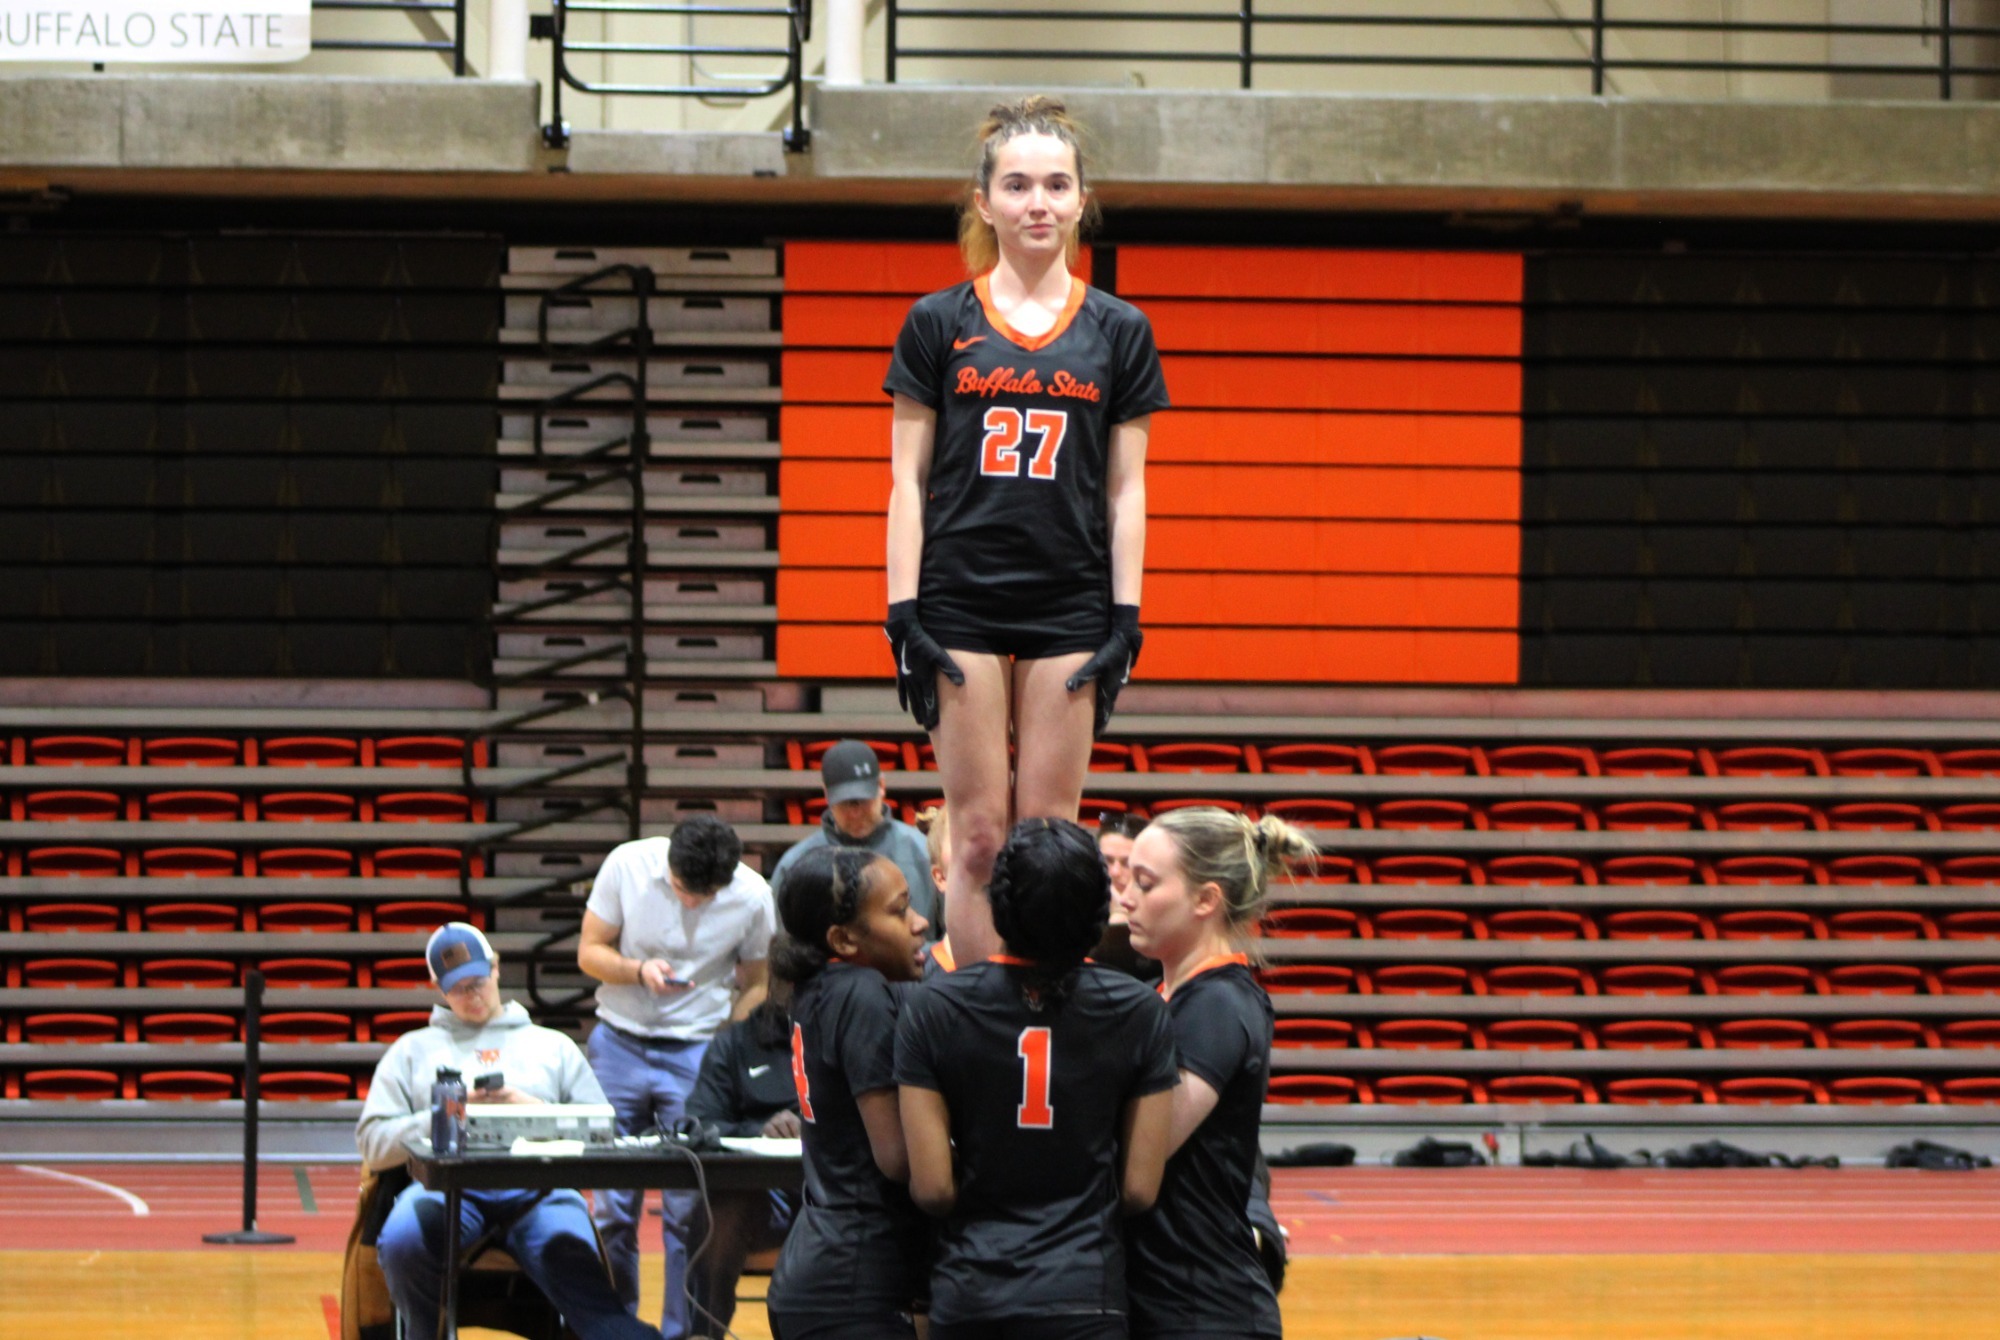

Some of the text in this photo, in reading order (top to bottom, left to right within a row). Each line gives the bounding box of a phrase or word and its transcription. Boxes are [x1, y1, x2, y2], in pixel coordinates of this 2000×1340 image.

[0, 11, 283, 48] UFFALO STATE
[954, 366, 1101, 402] Buffalo State
[980, 406, 1068, 480] 27
[1017, 1026, 1053, 1129] 1
